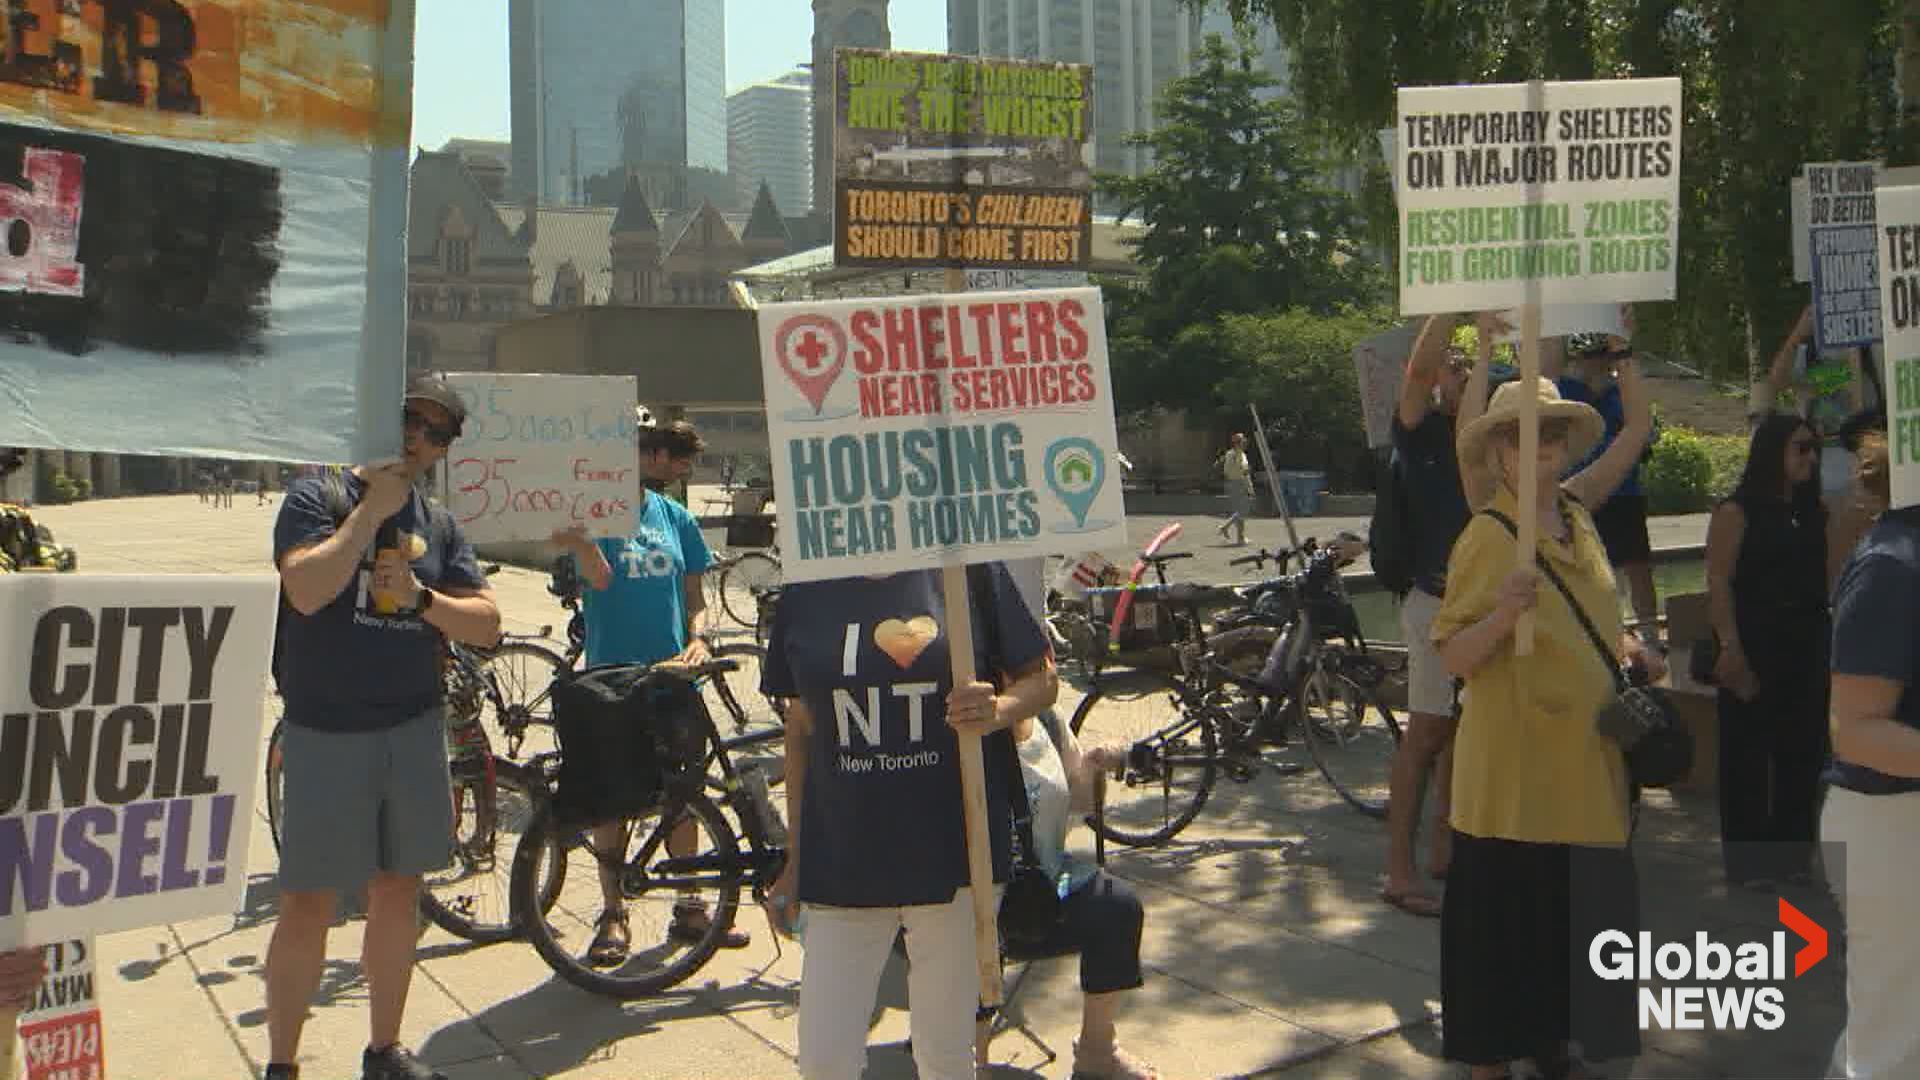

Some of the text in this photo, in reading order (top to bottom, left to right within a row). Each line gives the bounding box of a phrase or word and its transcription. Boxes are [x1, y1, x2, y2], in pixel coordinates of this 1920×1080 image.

[984, 96, 1083, 138] WORST
[1405, 106, 1672, 148] TEMPORARY SHELTERS
[1407, 142, 1672, 188] ON MAJOR ROUTES
[848, 189, 1083, 227] TORONTO'S CHILDREN
[1407, 200, 1671, 246] RESIDENTIAL ZONES
[848, 225, 1080, 262] SHOULD COME FIRST
[1407, 239, 1671, 287] FOR GROWING ROOTS
[851, 299, 1089, 374] SHELTERS
[857, 363, 1097, 419] NEAR SERVICES
[789, 422, 1028, 512] HOUSING
[796, 491, 1042, 561] NEAR HOMES
[29, 605, 237, 710] CITY
[842, 622, 861, 677] I
[832, 681, 938, 747] NT
[840, 755, 873, 773] New
[0, 795, 237, 917] NSEL!
